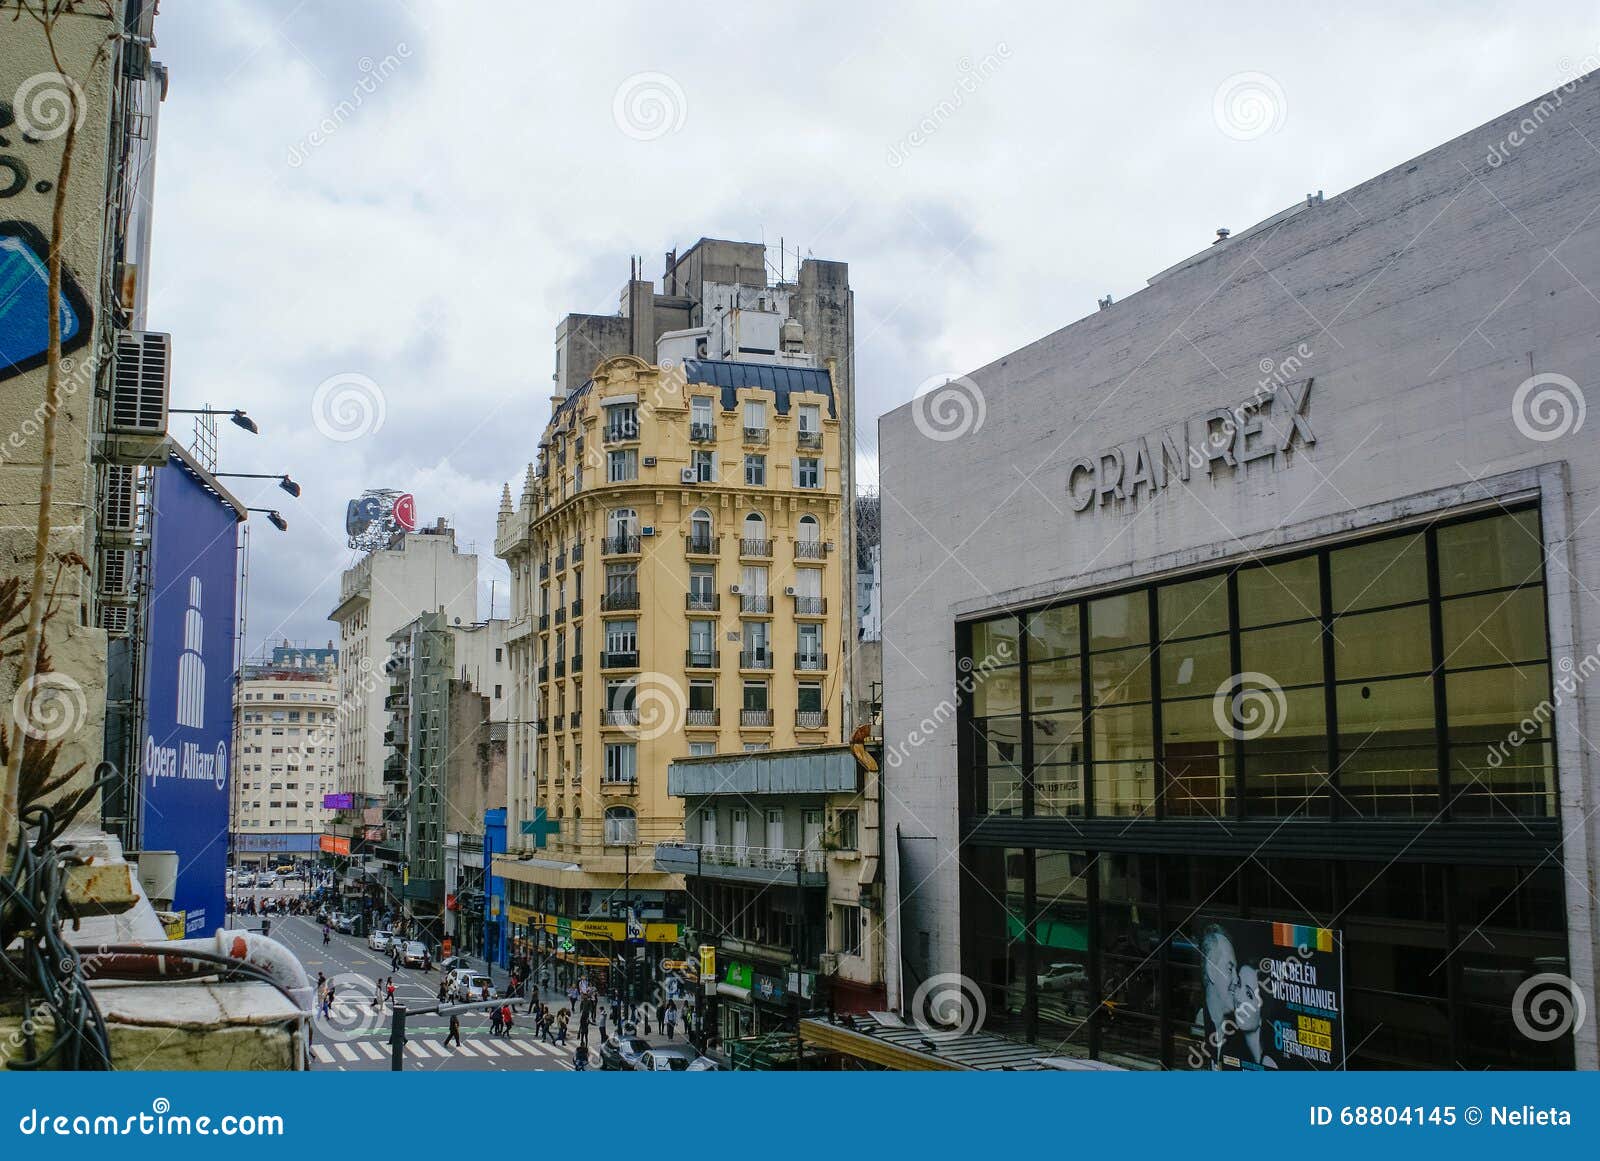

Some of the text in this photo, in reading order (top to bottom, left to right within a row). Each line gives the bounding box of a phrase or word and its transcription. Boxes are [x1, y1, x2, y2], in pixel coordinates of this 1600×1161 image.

[1203, 376, 1316, 474] REX
[145, 735, 215, 787] Opera Allianz
[1289, 961, 1316, 985] BELÉN
[1271, 979, 1301, 1003] VICTOR
[1302, 986, 1339, 1012] MANUEL
[1274, 1020, 1283, 1050] 8
[1320, 1049, 1332, 1064] REX
